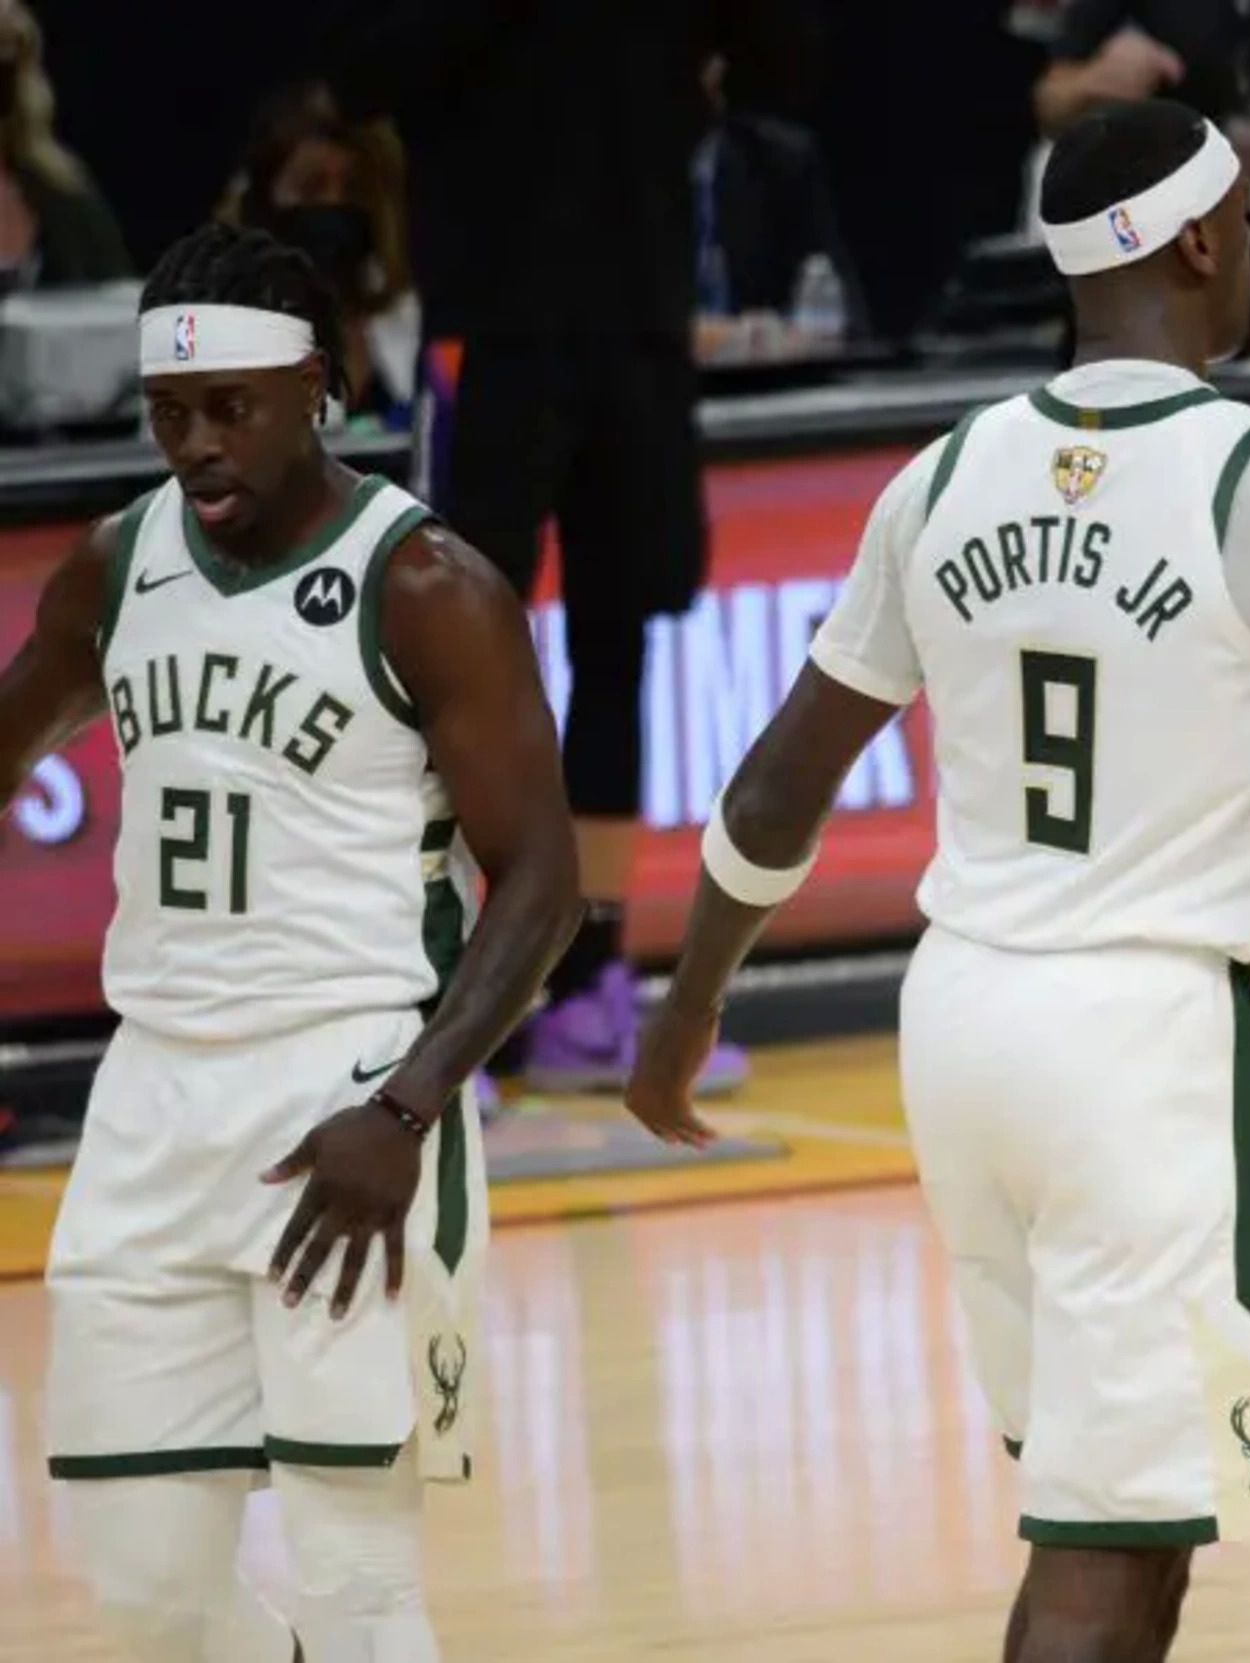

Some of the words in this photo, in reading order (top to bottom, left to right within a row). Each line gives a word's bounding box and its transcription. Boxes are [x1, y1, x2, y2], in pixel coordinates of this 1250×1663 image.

[935, 516, 1111, 622] PORTIS
[1115, 558, 1193, 640] JR
[112, 652, 354, 774] BUCKS
[1020, 649, 1096, 854] 9
[159, 787, 251, 913] 21
